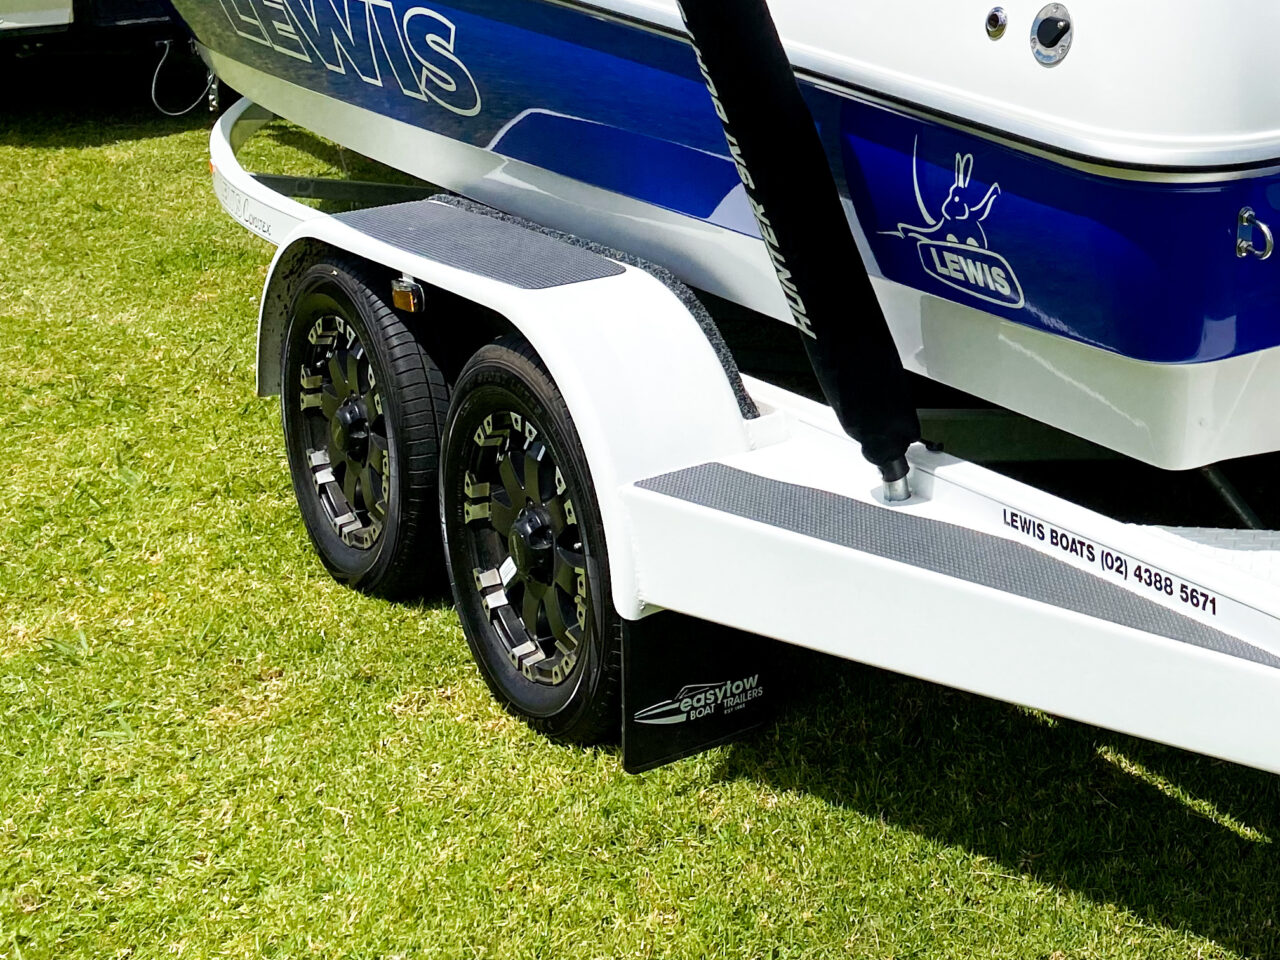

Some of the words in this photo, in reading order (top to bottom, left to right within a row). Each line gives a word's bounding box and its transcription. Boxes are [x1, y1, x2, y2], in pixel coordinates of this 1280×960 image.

[929, 246, 1011, 296] LEWIS
[1003, 508, 1045, 541] LEWIS
[1050, 528, 1095, 562] BOATS
[1101, 549, 1128, 580] (02)
[1133, 565, 1173, 596] 4388
[1179, 583, 1216, 615] 5671
[680, 674, 759, 712] easytow
[690, 703, 716, 720] BOAT
[723, 686, 763, 708] TRAILERS
